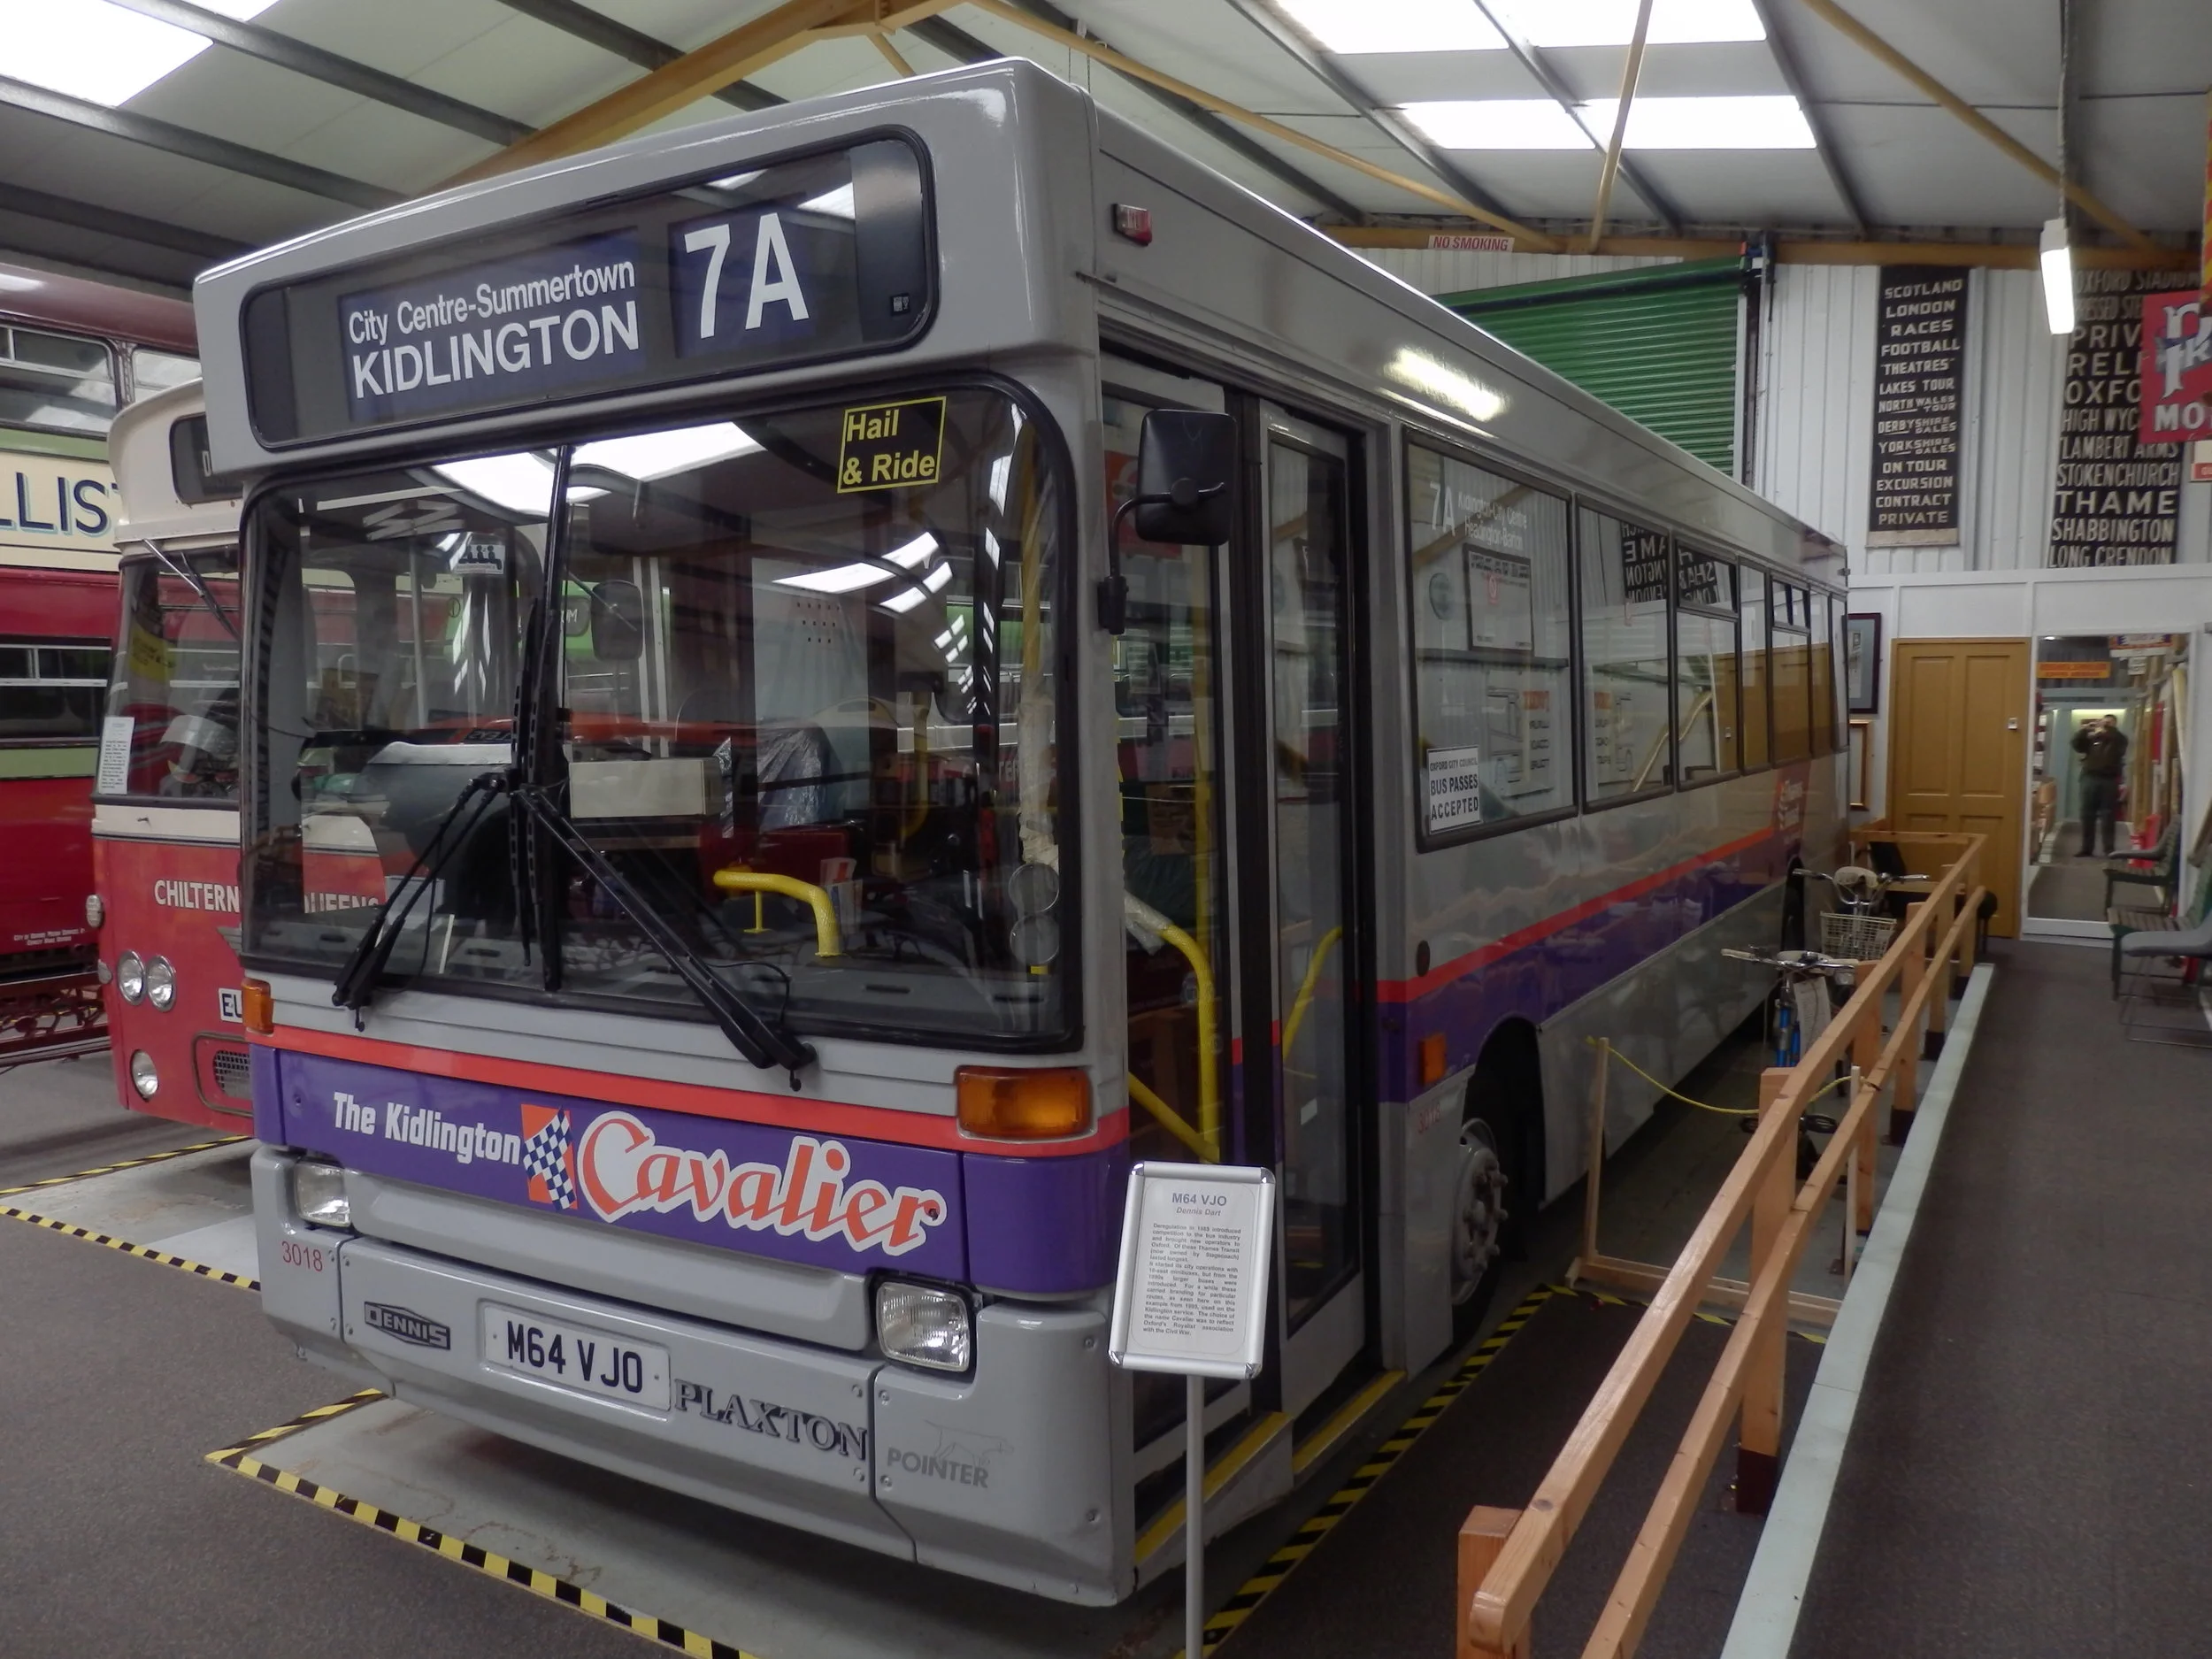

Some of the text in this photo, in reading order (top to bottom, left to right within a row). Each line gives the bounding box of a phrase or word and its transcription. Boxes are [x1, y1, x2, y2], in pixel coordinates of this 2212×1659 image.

[1433, 236, 1509, 251] NO SMOKING
[685, 212, 810, 339] 7A
[1885, 279, 1963, 299] SCOTLAND
[349, 261, 635, 345] City Centre-Summertown
[1886, 299, 1956, 319] LONDON
[1890, 319, 1954, 337] RACES
[2070, 324, 2142, 349] PRIV
[353, 300, 639, 398] KIDLINGTON
[1881, 338, 1961, 357] FOOTBALL
[1879, 377, 1955, 396] LAKES TOUR
[1878, 395, 1955, 413] NORTH WALES
[1924, 402, 1956, 412] TOUR
[847, 409, 899, 442] Hail
[1878, 417, 1951, 434] DERBYSHIRE
[1915, 421, 1957, 434] DALES
[2061, 408, 2100, 432] HIGH
[1878, 437, 1950, 454] YORKSHIRE
[1915, 443, 1956, 455] DALES
[843, 449, 935, 485] & Ride
[1883, 459, 1947, 473] ON TOUR
[2056, 463, 2181, 487] STOKENCHURCH
[1876, 476, 1954, 491] EXCURSION
[1430, 481, 1455, 536] 7A
[1876, 493, 1952, 508] CONTRACT
[2055, 490, 2178, 514] THAME
[1878, 511, 1949, 525] PRIVATE
[2052, 518, 2175, 541] SHABBINGTON
[2048, 545, 2172, 568] LONG CRENDON
[1430, 760, 1448, 772] OXFORD
[1449, 759, 1458, 769] CITY
[1430, 774, 1478, 796] BUS PASSES
[1431, 796, 1479, 820] ACCEPTED
[154, 879, 240, 913] CHILTERN
[334, 1091, 946, 1255] The Kidlington Cavalier
[1172, 1193, 1227, 1206] M64 VJO
[1176, 1206, 1202, 1215] Dennis
[281, 1240, 323, 1272] 3018
[365, 1303, 449, 1350] DENNIS
[507, 1320, 643, 1394] M64 VJO
[674, 1378, 868, 1461] PLAXTON
[887, 1446, 989, 1489] POINTER
